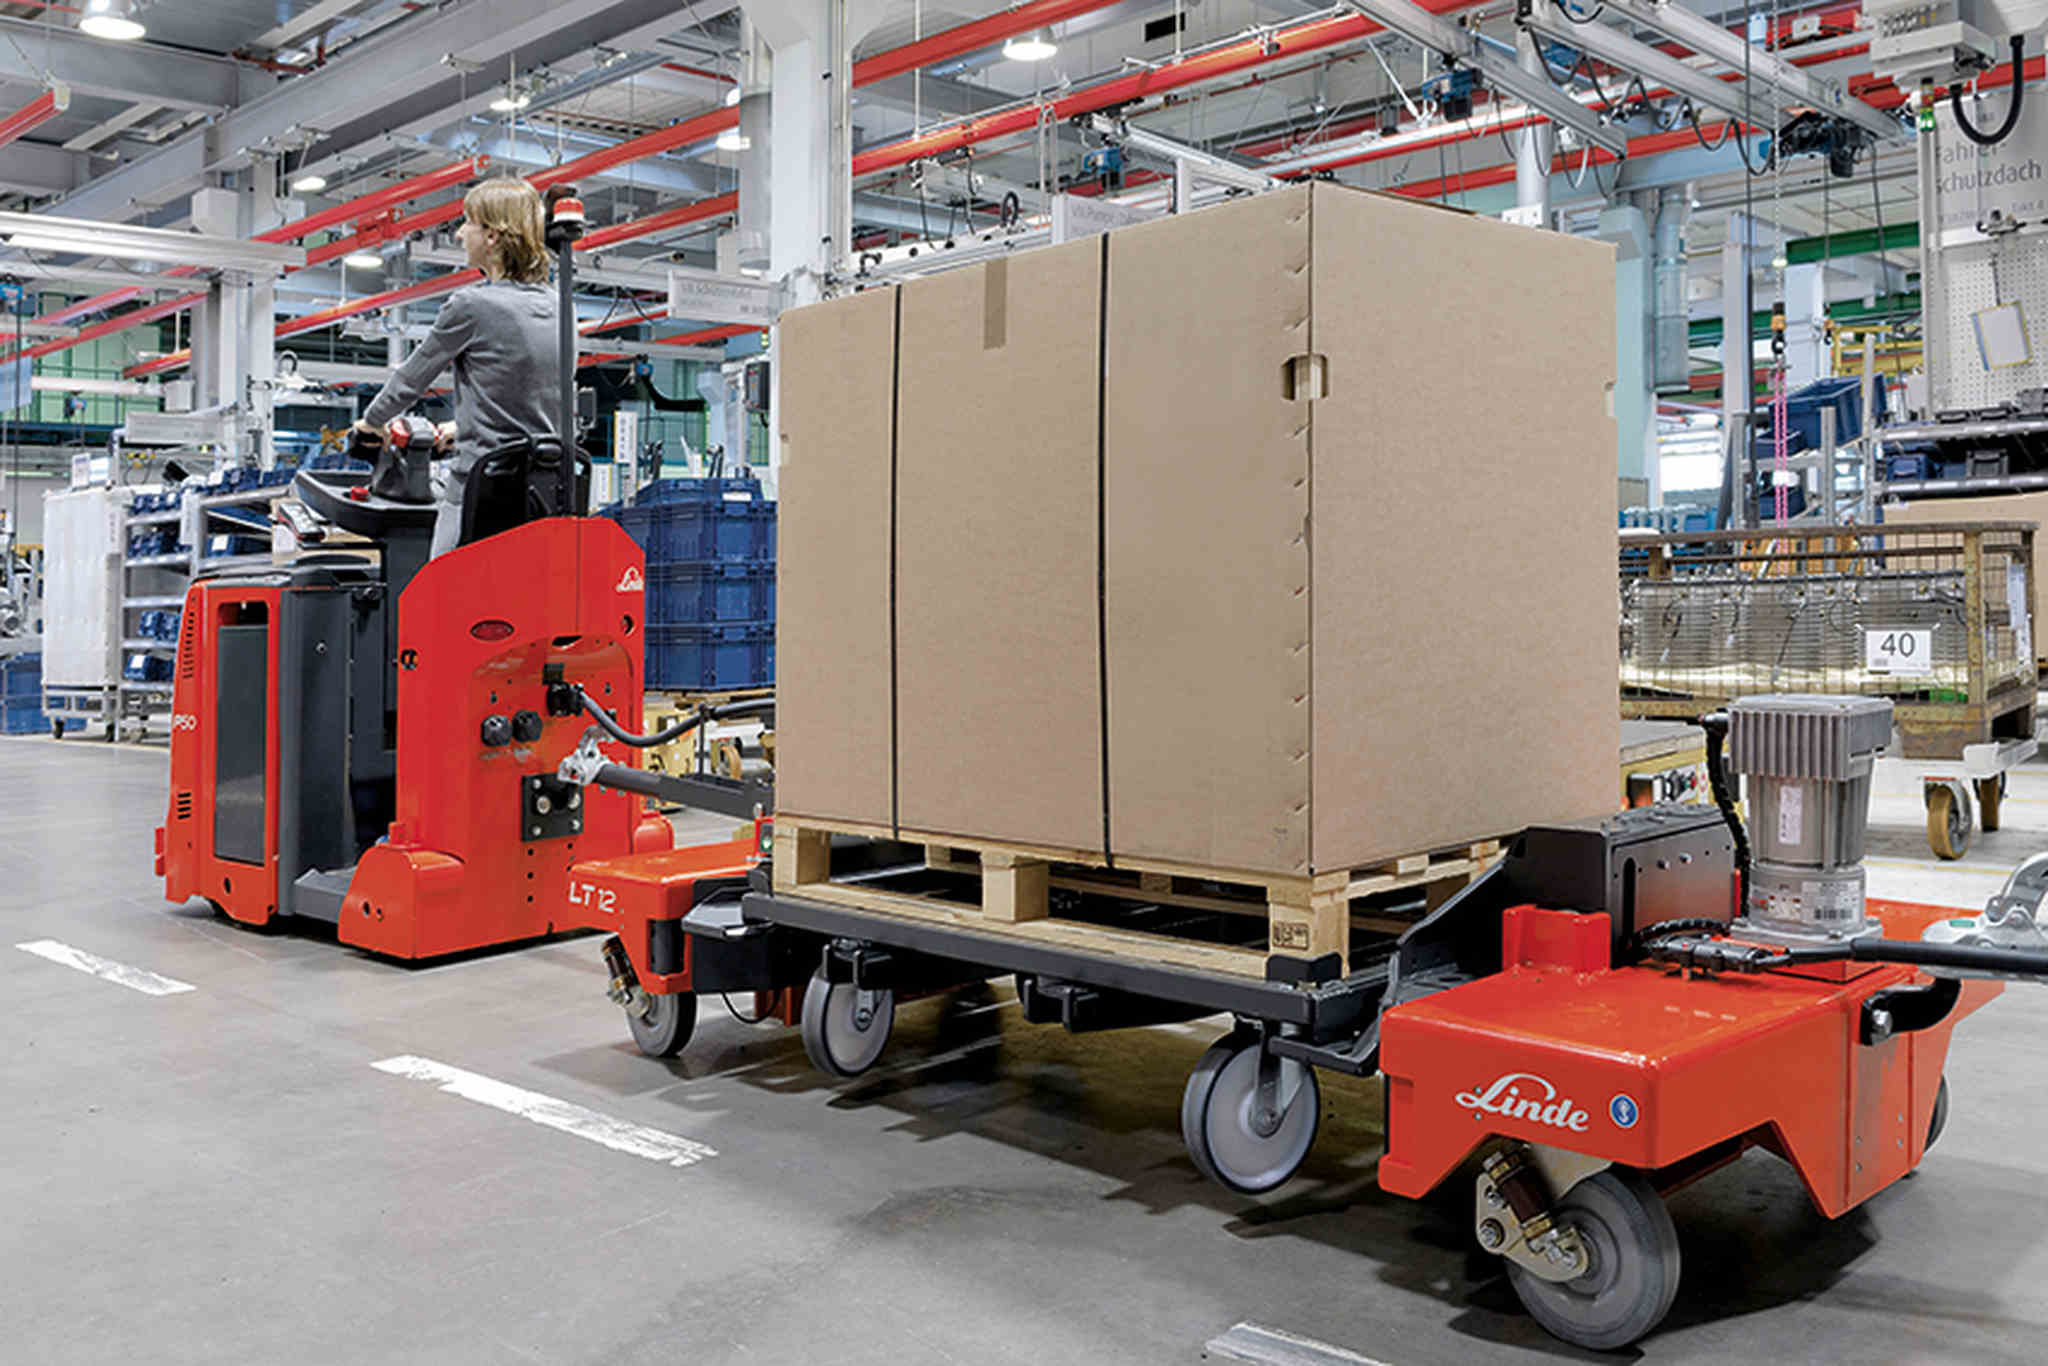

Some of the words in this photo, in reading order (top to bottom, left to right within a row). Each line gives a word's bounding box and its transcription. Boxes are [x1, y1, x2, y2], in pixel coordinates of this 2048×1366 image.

[1880, 632, 1915, 658] 40
[569, 881, 595, 907] LT
[598, 888, 616, 913] 12
[1455, 1073, 1589, 1131] Linde
